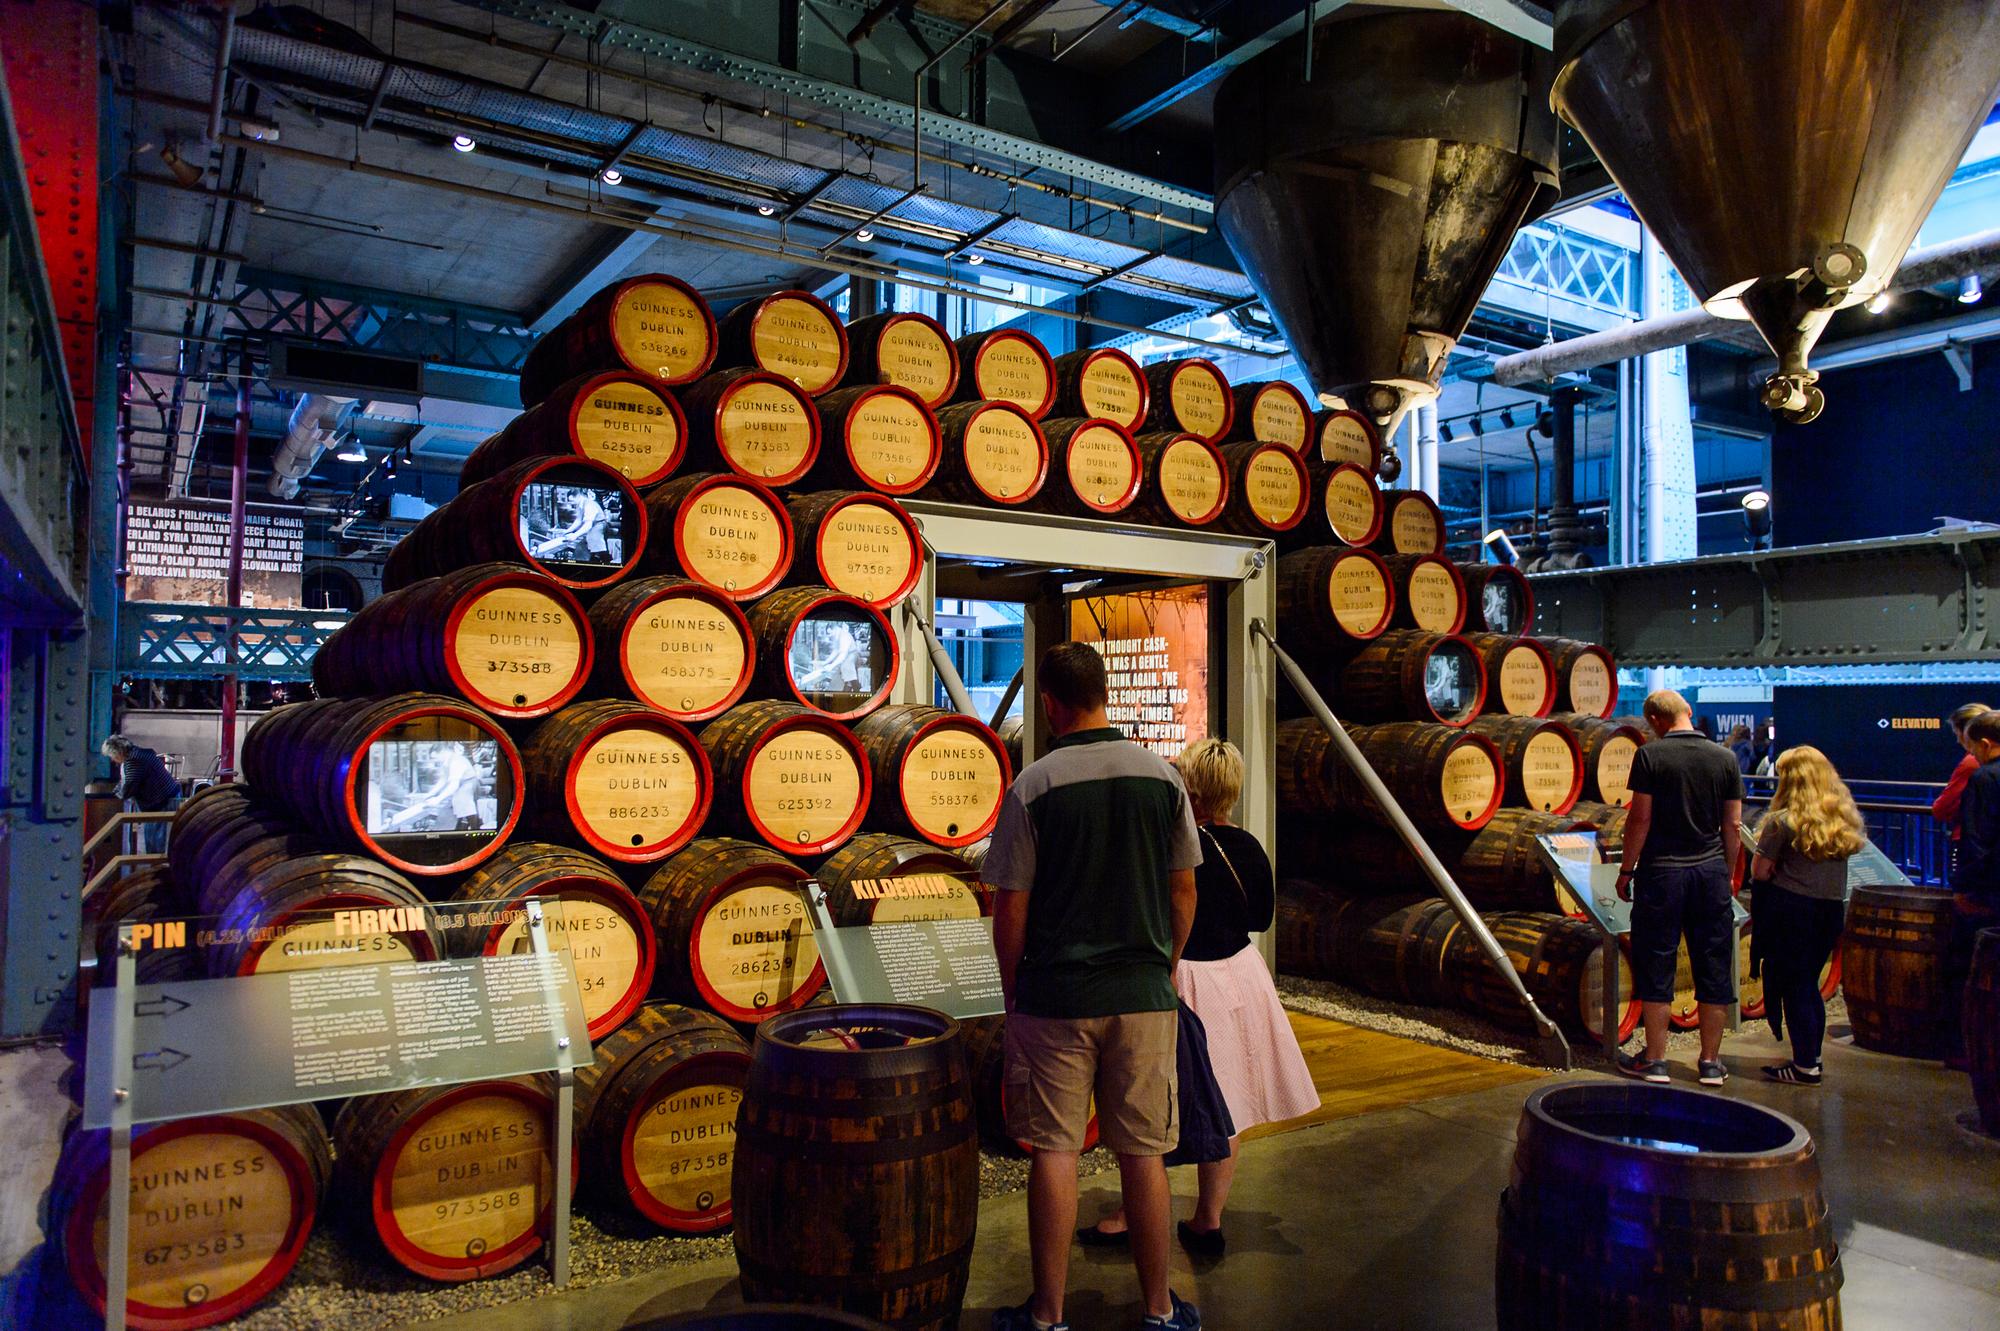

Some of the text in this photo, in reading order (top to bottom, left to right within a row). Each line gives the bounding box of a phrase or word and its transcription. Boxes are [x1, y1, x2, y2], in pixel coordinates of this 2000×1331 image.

[632, 302, 694, 319] GUINNESS
[641, 322, 684, 335] DUBLIN
[772, 316, 826, 334] GUINNESS
[779, 337, 818, 350] DUBLIN
[892, 336, 940, 351] GUINNESS
[898, 355, 932, 368] DUBLIN
[990, 352, 1036, 366] GUINNESS
[997, 369, 1029, 380] DUBLIN
[1091, 369, 1132, 384] GUINNESS
[1096, 386, 1126, 398] DUBLIN
[1179, 378, 1216, 392] GUINNESS
[1186, 394, 1212, 405] DUBLIN
[594, 399, 664, 416] GUINNESS
[735, 401, 796, 414] GUINNESS
[1262, 401, 1297, 415] GUINNESS
[604, 419, 652, 434] DUBLIN
[744, 421, 787, 432] DUBLIN
[864, 413, 918, 428] GUINNESS
[1267, 416, 1292, 428] DUBLIN
[872, 432, 911, 444] DUBLIN
[979, 426, 1028, 440] GUINNESS
[602, 440, 652, 455] 625368
[986, 444, 1020, 456] DUBLIN
[1080, 440, 1124, 454] GUINNESS
[1336, 443, 1359, 454] DUBLIN
[1086, 458, 1118, 469] DUBLIN
[1170, 456, 1211, 469] GUINNESS
[1255, 464, 1293, 476] GUINNESS
[1176, 472, 1205, 483] DUBLIN
[1260, 480, 1288, 489] DUBLIN
[1335, 480, 1368, 497] GUINNESS
[1338, 496, 1362, 508] DUBLIN
[136, 506, 176, 518] BELARUS
[179, 510, 232, 522] PHILIPPINES
[700, 504, 768, 522] GUINNESS
[152, 520, 182, 530] JAPAN
[184, 522, 230, 534] GIBRALTAR
[710, 526, 758, 540] DUBLIN
[838, 522, 898, 535] GUINNESS
[128, 530, 160, 540] ERLAND
[163, 532, 189, 542] SYRIA
[192, 534, 224, 545] TAIWAN
[268, 540, 286, 550] IRAN
[138, 542, 184, 554] LITHUANIA
[186, 546, 220, 556] JORDAN
[256, 550, 292, 560] UKRAINE
[847, 542, 889, 553] DUBLIN
[131, 553, 158, 564] OMAN
[161, 555, 195, 566] POLAND
[134, 565, 186, 578] YUGOSLAVIA
[1337, 570, 1376, 579] GUINNESS
[1415, 576, 1448, 586] GUINNESS
[1344, 586, 1371, 594] DUBLIN
[1421, 590, 1444, 600] DUBLIN
[476, 609, 562, 624] GUINNESS
[650, 617, 726, 632] GUINNESS
[490, 633, 550, 647] DUBLIN
[1106, 638, 1142, 654] THOUGHT
[1144, 636, 1168, 652] CASK-
[662, 642, 713, 653] DUBLIN
[488, 660, 552, 674] 373588
[1112, 656, 1130, 671] WAS
[1131, 655, 1137, 670] A
[1138, 654, 1169, 670] GENTLE
[661, 666, 714, 678] 458375
[1108, 672, 1178, 688] THINK AGAIN. THE
[1120, 690, 1168, 704] COOPERAGE
[1169, 688, 1188, 704] WAS
[1140, 706, 1174, 722] TIMBER
[1892, 718, 1940, 730] ELEVATOR
[1138, 724, 1186, 740] CARPENTRY
[769, 750, 842, 761] GUINNESS
[922, 748, 985, 759] GUINNESS
[1530, 746, 1564, 754] GUINNESS
[596, 752, 680, 764] GUINNESS
[1448, 757, 1486, 768] GUINNESS
[1535, 762, 1560, 770] DUBLIN
[780, 772, 832, 784] DUBLIN
[931, 770, 976, 780] DUBLIN
[1453, 774, 1480, 784] DUBLIN
[609, 778, 668, 790] DUBLIN
[778, 798, 832, 810] 625392
[930, 795, 978, 806] 558376
[609, 806, 670, 818] 886233
[851, 876, 949, 900] KILDERKIN
[720, 903, 802, 920] GUINNESS
[334, 907, 426, 936] FIRKIN
[468, 909, 537, 927] GALLONS
[132, 922, 186, 950] PIN
[733, 929, 792, 945] DUBLIN
[732, 958, 792, 976] 286239
[656, 1090, 742, 1115] GUINNES
[418, 1122, 534, 1153] GUINNESS
[671, 1120, 738, 1144] DUBLIN
[438, 1156, 518, 1183] DUBLIN
[670, 1152, 734, 1175] 87358
[130, 1156, 265, 1194] GUINNESS
[146, 1195, 244, 1227] DUBLIN
[436, 1192, 520, 1220] 973588
[144, 1233, 246, 1266] 673583
